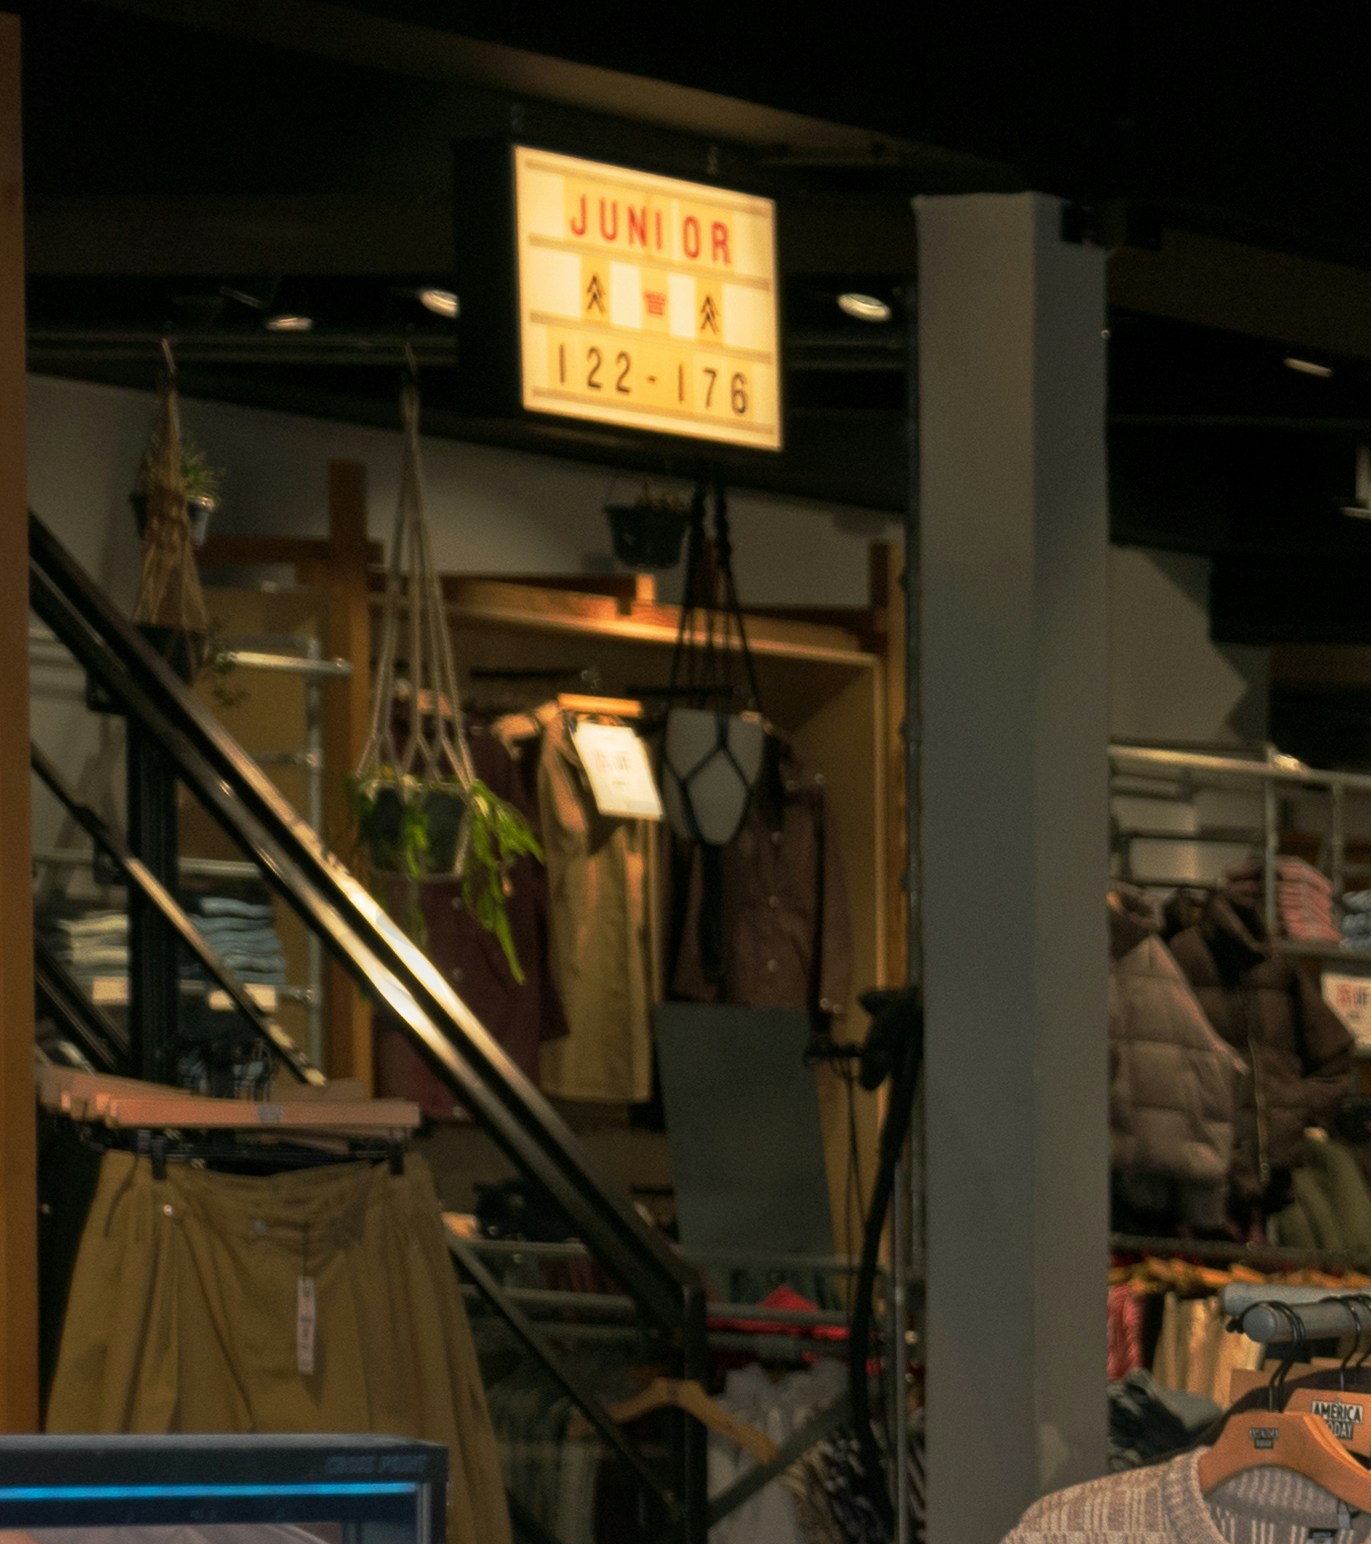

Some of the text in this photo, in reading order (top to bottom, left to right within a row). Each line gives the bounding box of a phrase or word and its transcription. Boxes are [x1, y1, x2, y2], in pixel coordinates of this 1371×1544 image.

[570, 193, 733, 266] JUNIOR
[557, 343, 749, 416] 122-176
[1313, 1401, 1362, 1422] AMERICA
[1325, 1420, 1353, 1439] ODAY
